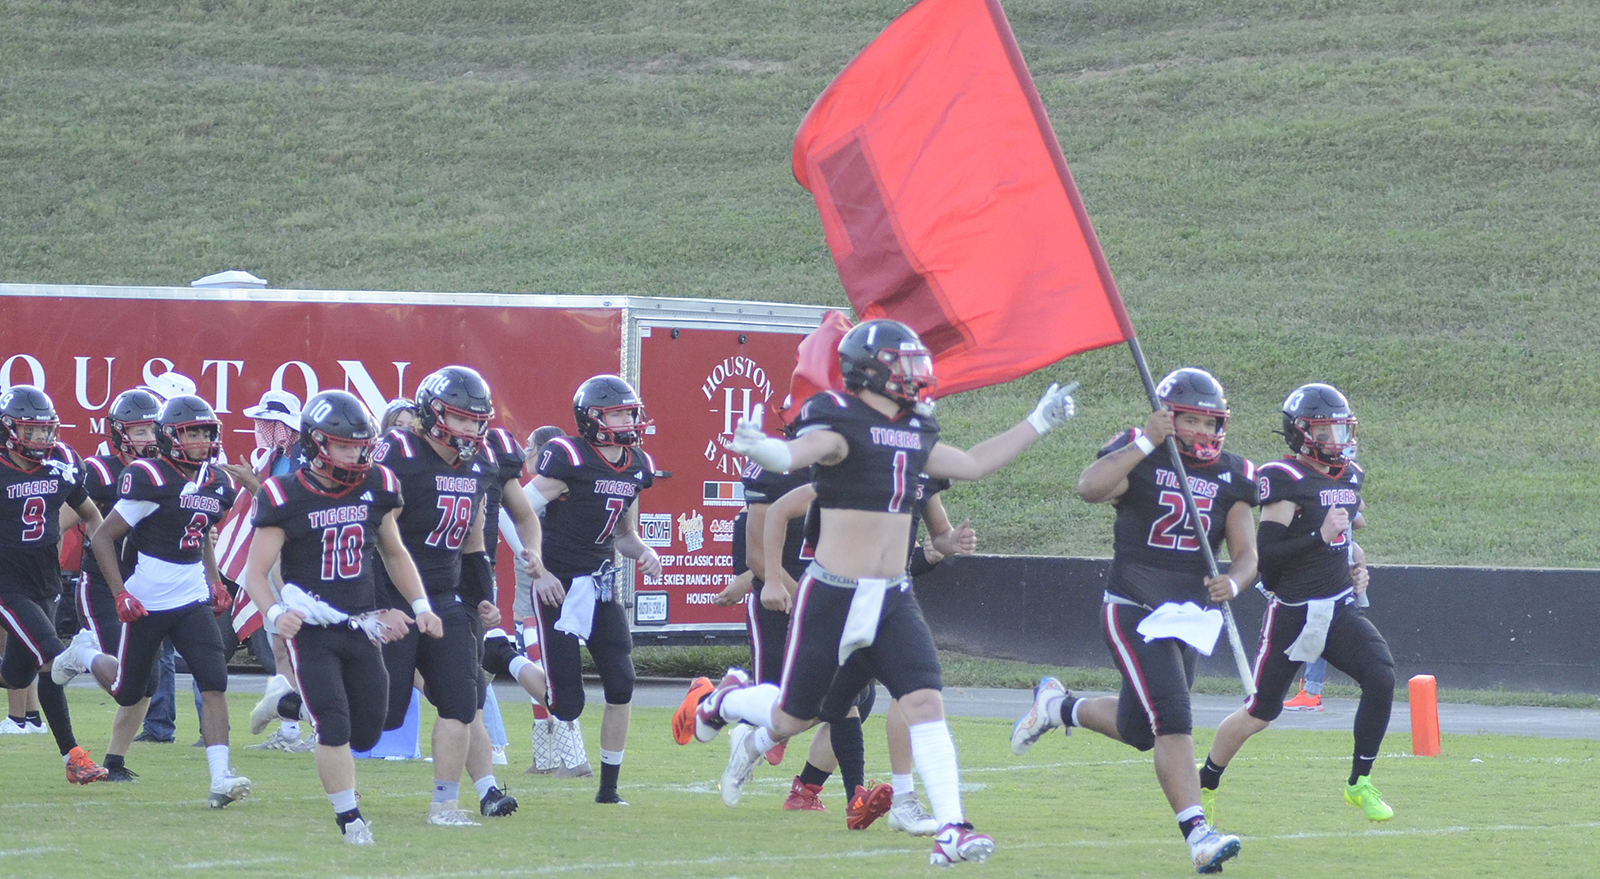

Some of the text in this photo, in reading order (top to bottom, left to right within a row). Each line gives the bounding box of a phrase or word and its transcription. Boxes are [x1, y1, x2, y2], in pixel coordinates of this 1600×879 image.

[867, 325, 877, 345] 1
[0, 354, 411, 422] OUSTON
[702, 355, 774, 403] HOUSTON
[309, 399, 332, 423] 10
[722, 387, 753, 435] H
[1290, 392, 1304, 411] 3
[870, 427, 921, 450] TIGERS
[539, 450, 552, 470] 7
[704, 439, 749, 476] BAN
[7, 480, 58, 498] TIGERS
[122, 473, 132, 494] 8
[435, 475, 477, 493] TIGERS
[594, 480, 635, 497] TIGERS
[888, 451, 907, 512] 1
[1260, 476, 1270, 500] 3
[179, 494, 220, 512] TIGERS
[1320, 489, 1356, 506] TIGERS
[22, 496, 46, 541] 9
[308, 505, 367, 528] TIGERS
[425, 495, 472, 549] 78
[595, 498, 624, 544] 7
[1147, 490, 1213, 551] 25
[321, 524, 364, 580] 10
[676, 555, 684, 566] IT
[684, 555, 714, 567] CLASSIC
[643, 574, 662, 585] BLUE
[663, 574, 685, 585] SKIES
[685, 574, 711, 585] RANCH
[712, 574, 723, 585] OF
[686, 593, 719, 604] HOUSTO
